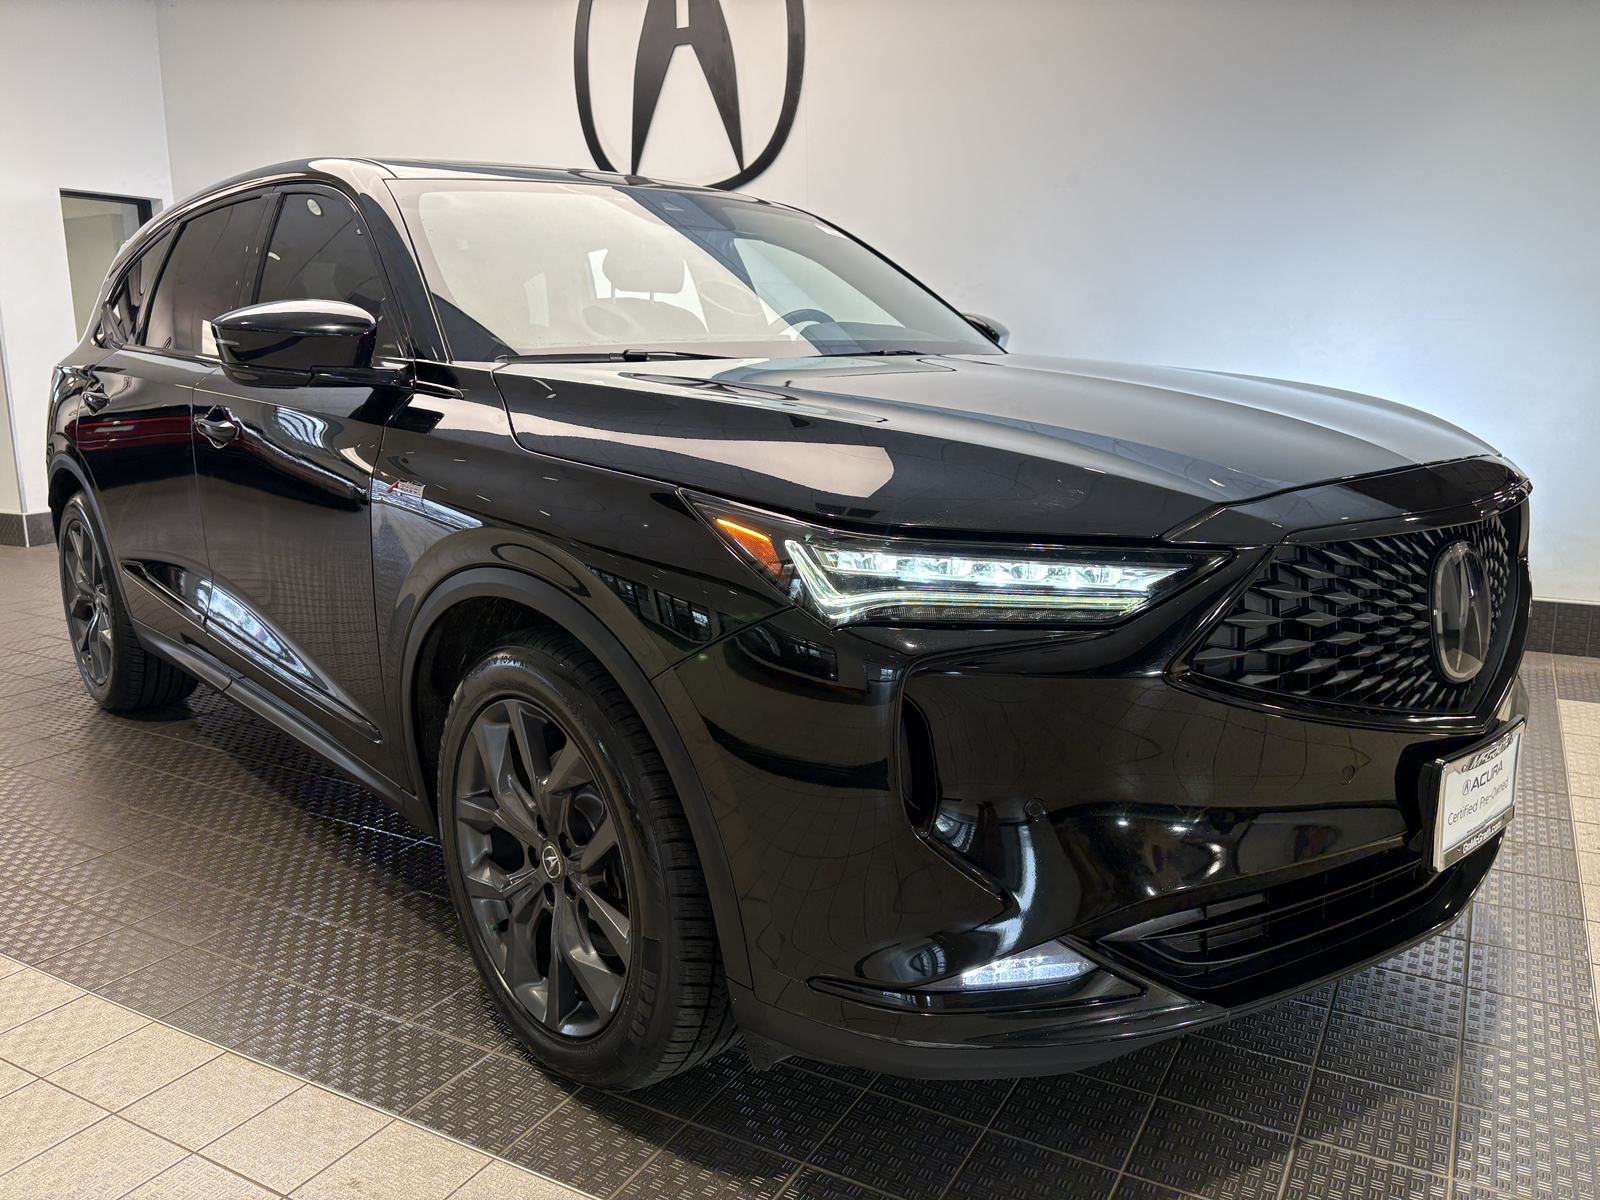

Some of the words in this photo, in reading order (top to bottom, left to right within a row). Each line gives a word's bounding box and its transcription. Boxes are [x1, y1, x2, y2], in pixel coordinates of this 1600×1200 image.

[1470, 760, 1503, 791] ACURA
[1447, 800, 1479, 826] Certified
[1480, 776, 1509, 809] Pre-Owned
